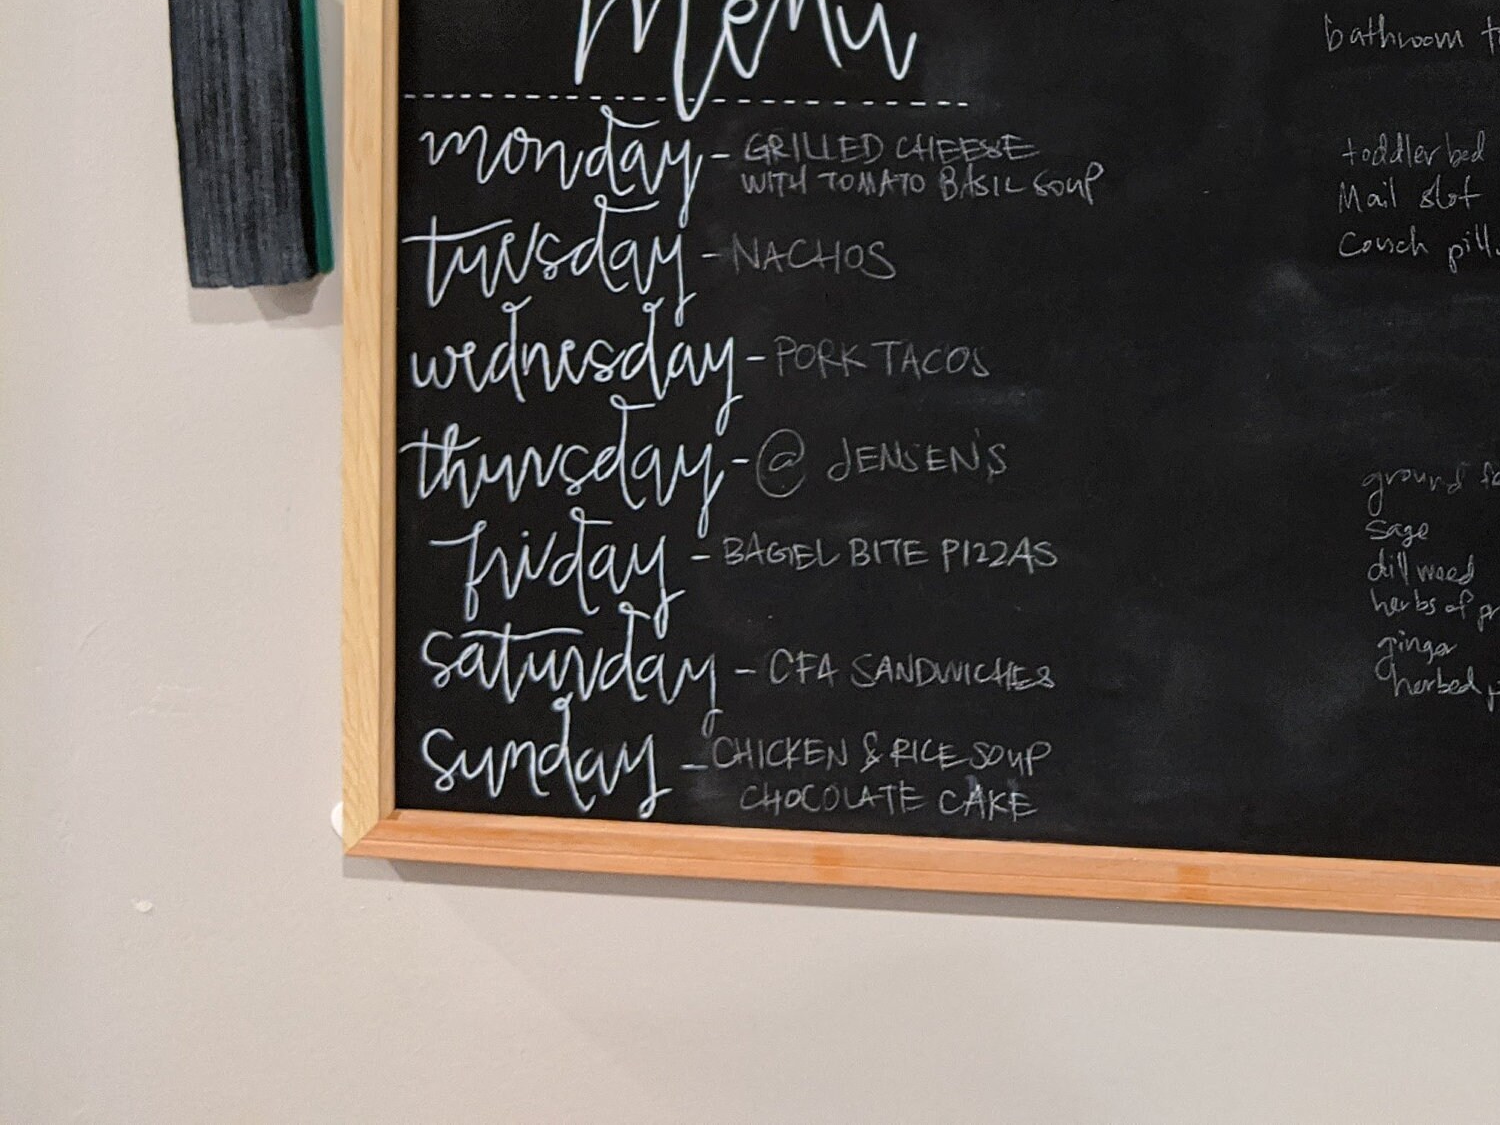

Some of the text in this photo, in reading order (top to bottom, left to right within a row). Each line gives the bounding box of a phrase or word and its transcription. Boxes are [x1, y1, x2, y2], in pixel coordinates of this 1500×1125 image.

[1324, 13, 1465, 52] bathroom
[418, 104, 1041, 227] monday GRILLED CHEESE
[1342, 132, 1441, 168] toddler
[1445, 130, 1487, 166] bed
[740, 164, 807, 198] WITH
[818, 168, 926, 198] TOMATO
[939, 163, 1025, 202] BASIL
[1339, 175, 1482, 214] Mail slot
[402, 195, 896, 325] tuesday NACHOS
[410, 298, 990, 436] wednesday PORK TACOS
[400, 395, 725, 538] thursday
[756, 429, 805, 498] @
[1362, 462, 1471, 517] ground
[430, 507, 1058, 640] friday BAGEL BITE PIZZAS
[1367, 548, 1474, 585] dill weed
[1370, 588, 1436, 616] herbs
[1445, 589, 1474, 619] of
[770, 648, 840, 687] CFA
[851, 652, 1055, 690] SANDWICHES
[1393, 666, 1482, 697] herbed
[712, 735, 849, 771] CHICKEN
[860, 731, 883, 773] &
[890, 737, 966, 770] RICE
[740, 780, 1038, 821] CHOCOLATE CAKE
